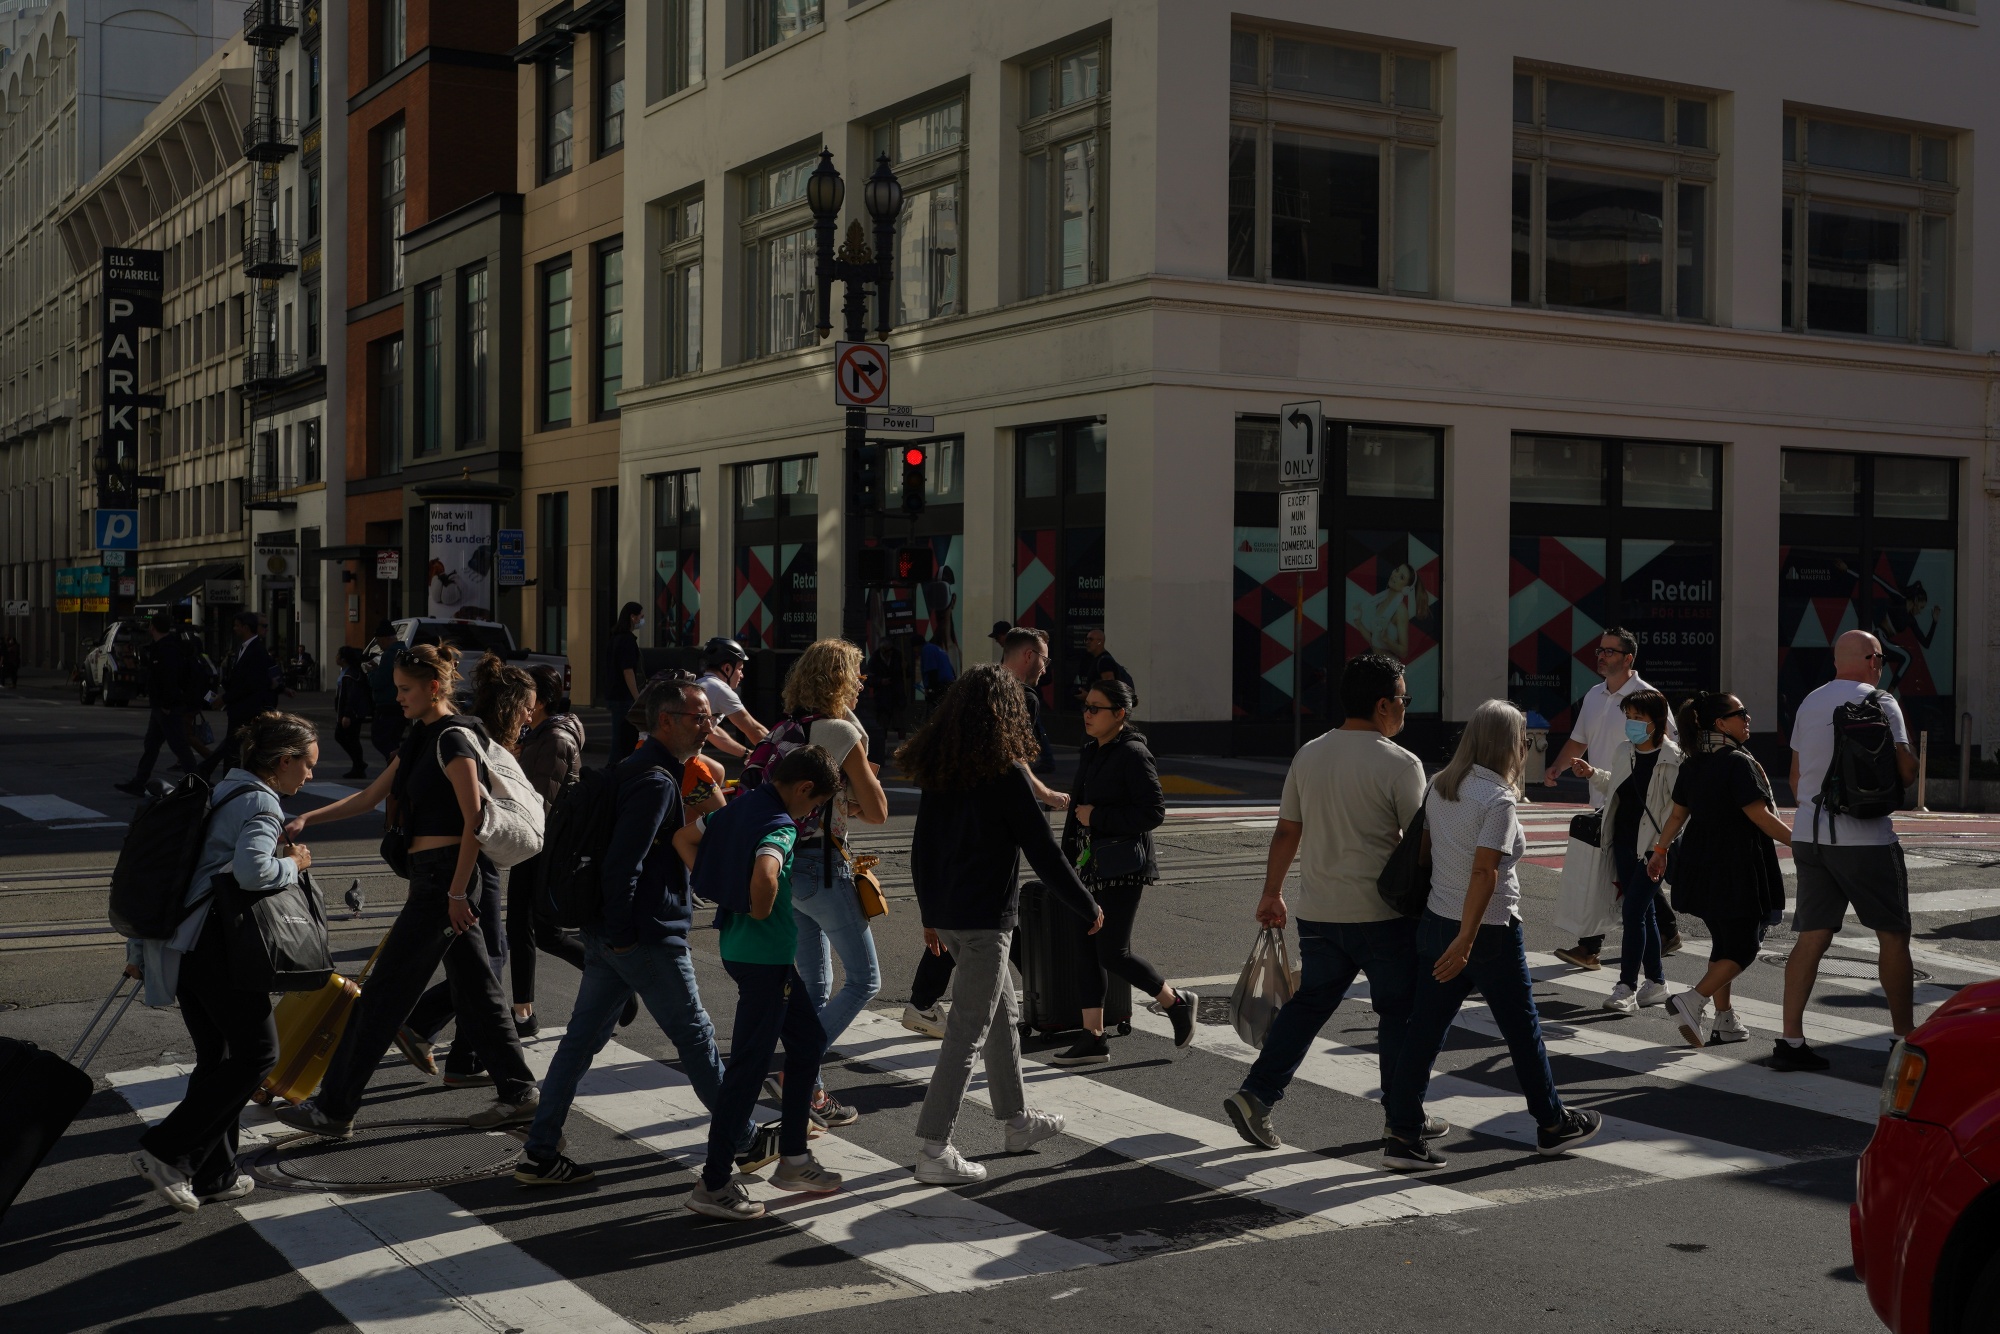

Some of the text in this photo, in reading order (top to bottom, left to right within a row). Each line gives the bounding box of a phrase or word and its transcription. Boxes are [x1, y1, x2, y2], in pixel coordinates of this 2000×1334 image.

[897, 406, 910, 414] 200
[883, 417, 918, 428] Powell
[1284, 459, 1314, 475] ONLY
[1287, 495, 1310, 507] EXCEPT
[430, 510, 473, 519] What will
[1291, 510, 1306, 521] MUNI
[430, 522, 466, 533] you find
[1290, 525, 1307, 536] TAXIS
[430, 534, 492, 544] $15 & under?
[1281, 539, 1315, 551] COMMERCIAL
[1284, 554, 1313, 565] VEHICLES
[792, 572, 817, 589] Retai
[1078, 576, 1104, 589] Retail
[1651, 579, 1713, 601] Retail
[783, 612, 792, 622] 415
[793, 612, 804, 622] 658
[1068, 607, 1078, 616] 415
[1079, 607, 1089, 616] 658
[1651, 607, 1713, 618] FOR LEASE
[1635, 631, 1715, 645] 15 658 3600
